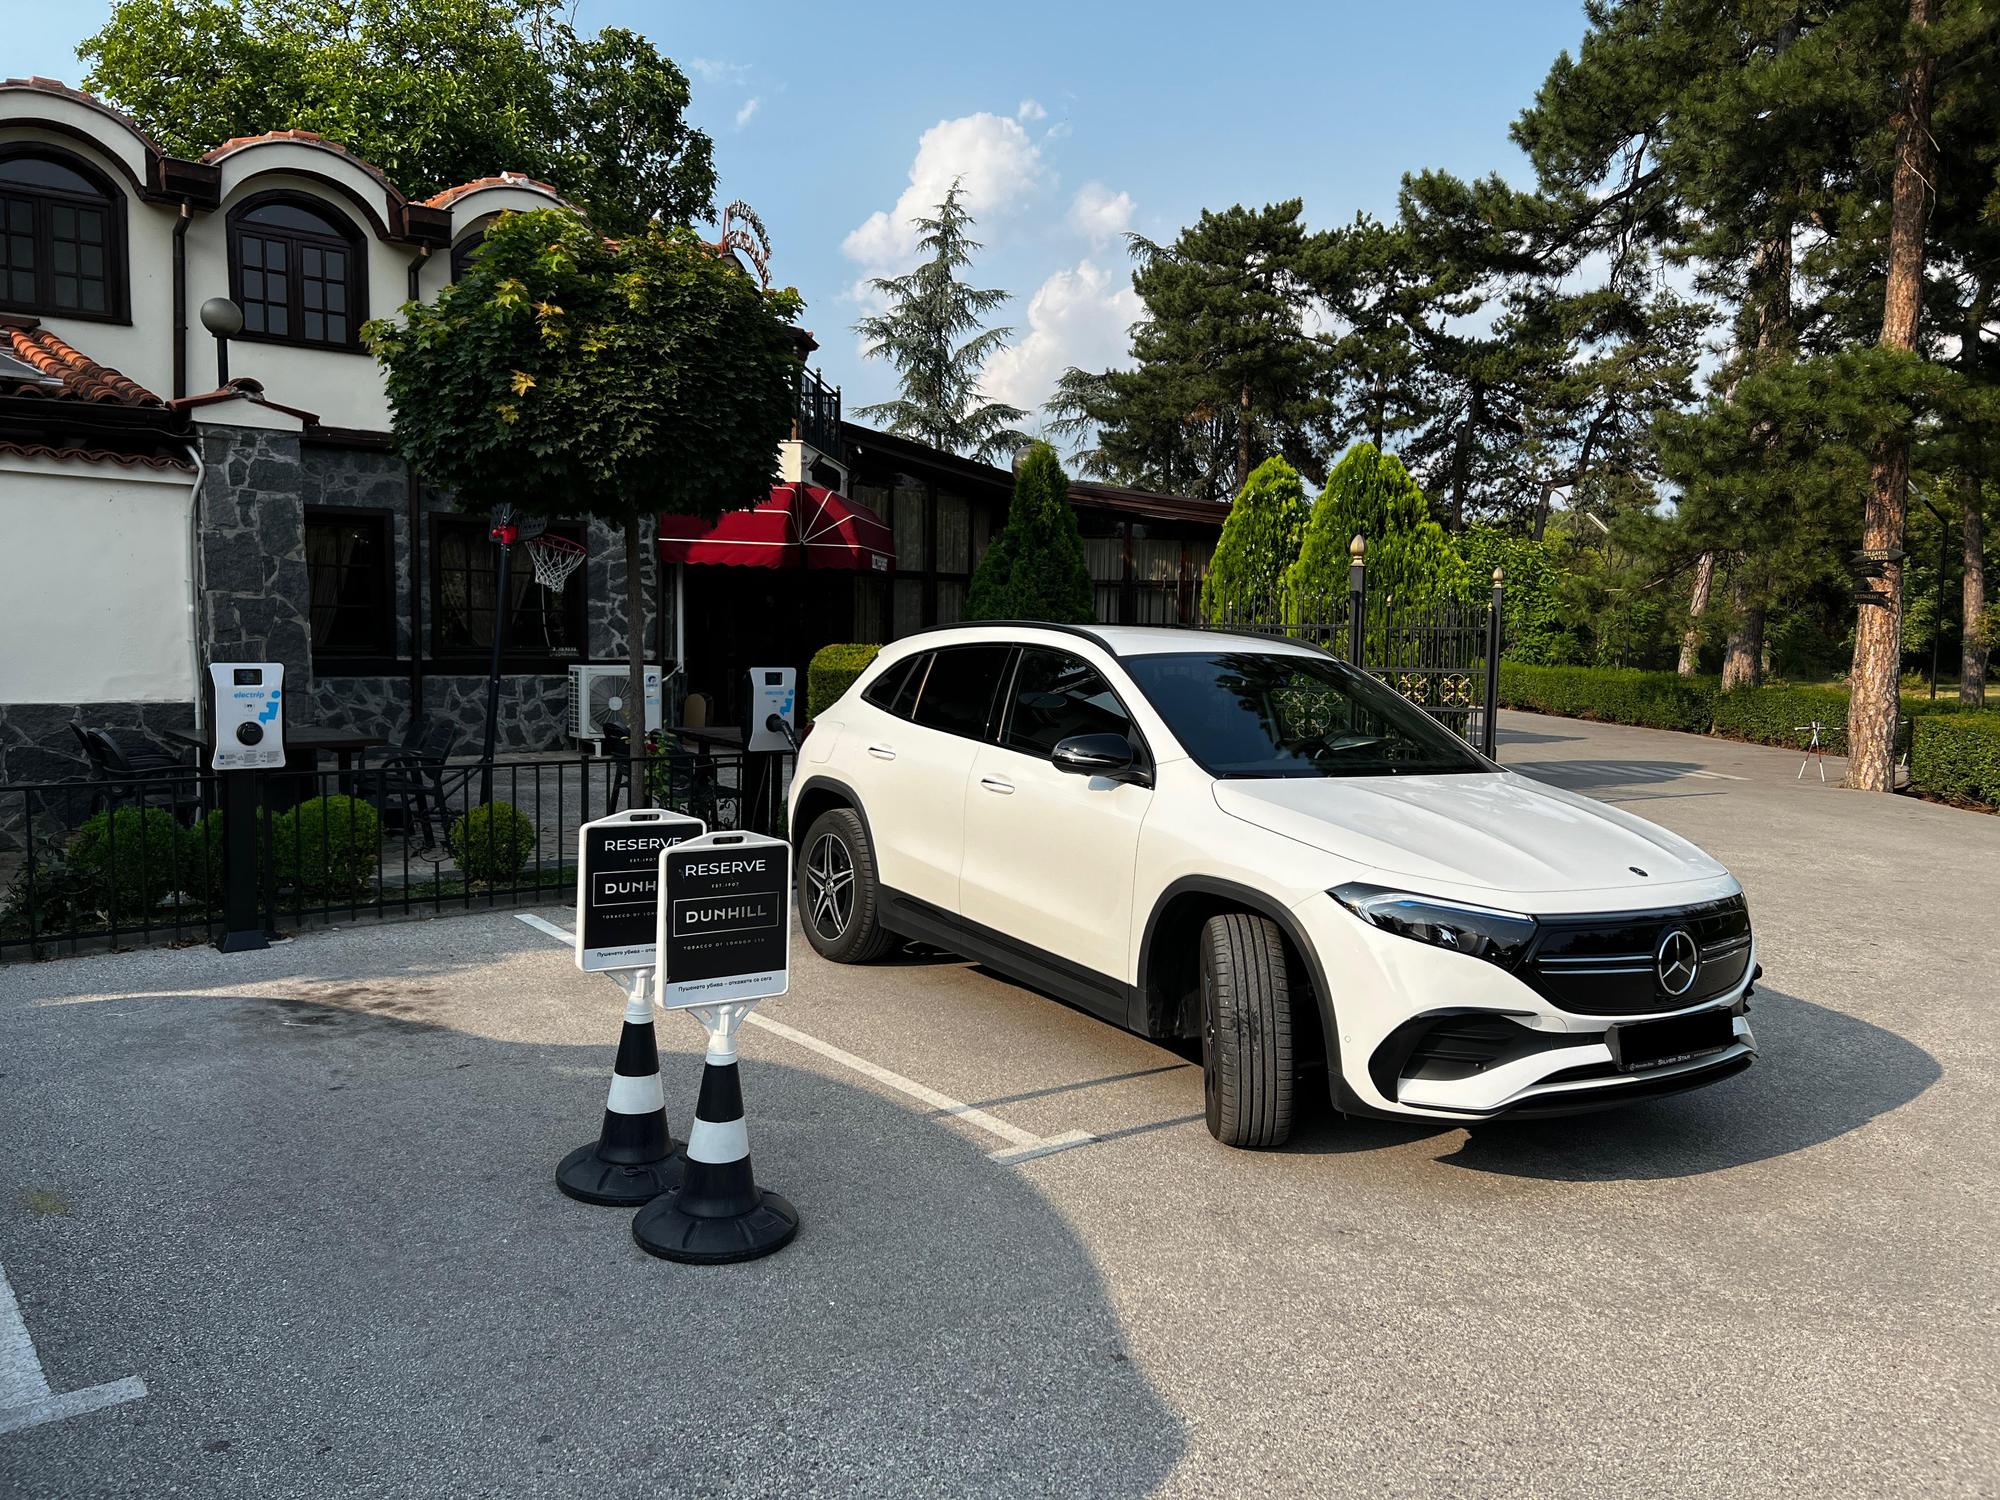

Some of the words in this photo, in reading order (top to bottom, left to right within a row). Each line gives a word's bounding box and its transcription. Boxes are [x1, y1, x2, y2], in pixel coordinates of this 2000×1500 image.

[234, 690, 265, 699] electrip
[604, 837, 682, 852] RESERVE
[685, 859, 766, 877] RESERVE
[605, 881, 657, 895] DUNH
[686, 904, 767, 924] DUNHILL
[678, 984, 706, 992] Пушенето
[706, 981, 723, 990] убива
[1657, 1057, 1677, 1066] SILVER
[1677, 1054, 1691, 1062] STAR
